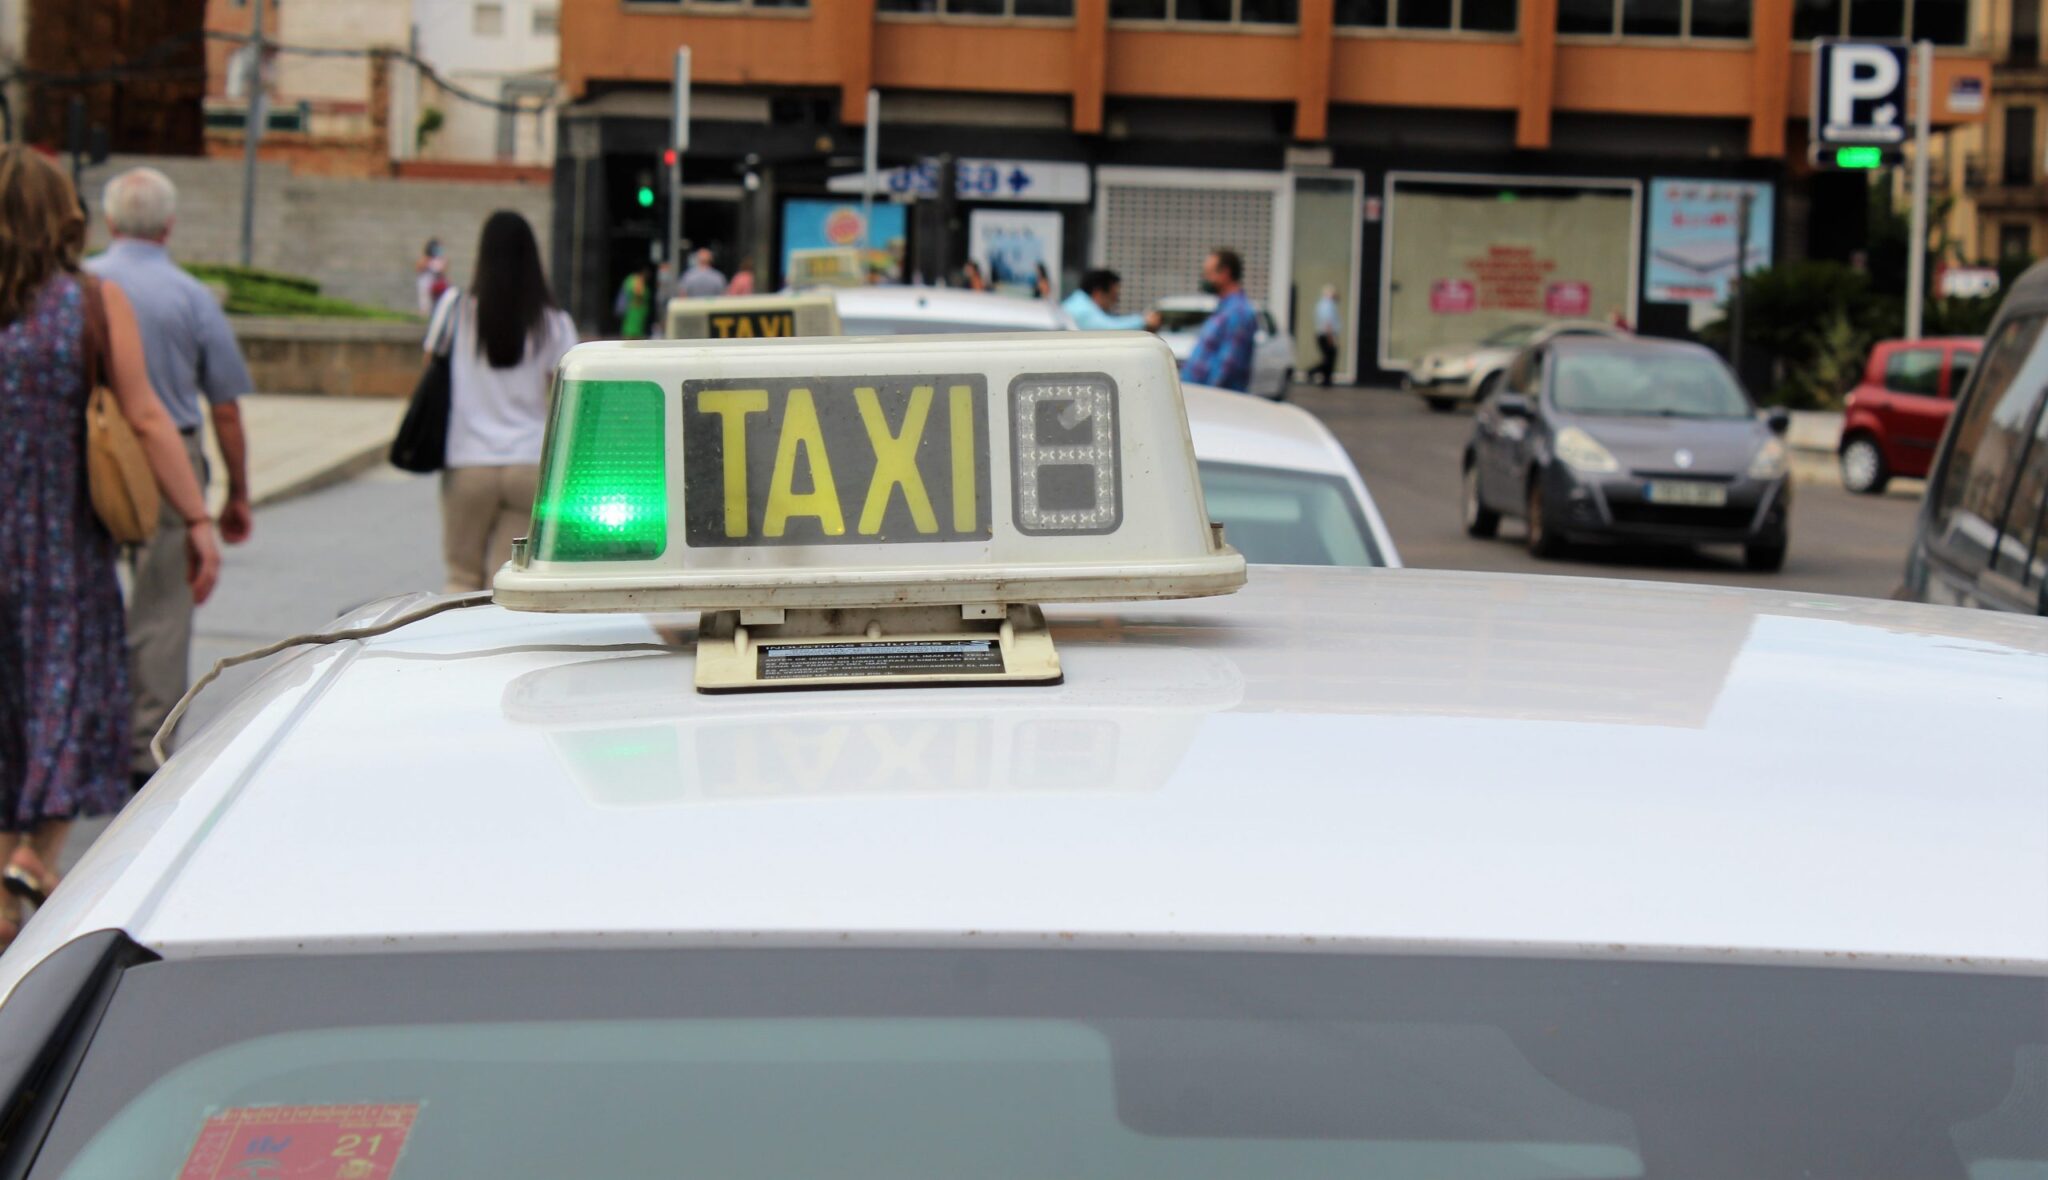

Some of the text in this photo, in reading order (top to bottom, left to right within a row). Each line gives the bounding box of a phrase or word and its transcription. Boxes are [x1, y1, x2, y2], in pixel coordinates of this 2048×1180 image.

[1829, 45, 1900, 127] P
[697, 384, 978, 538] TAXI
[331, 1132, 384, 1157] 21
